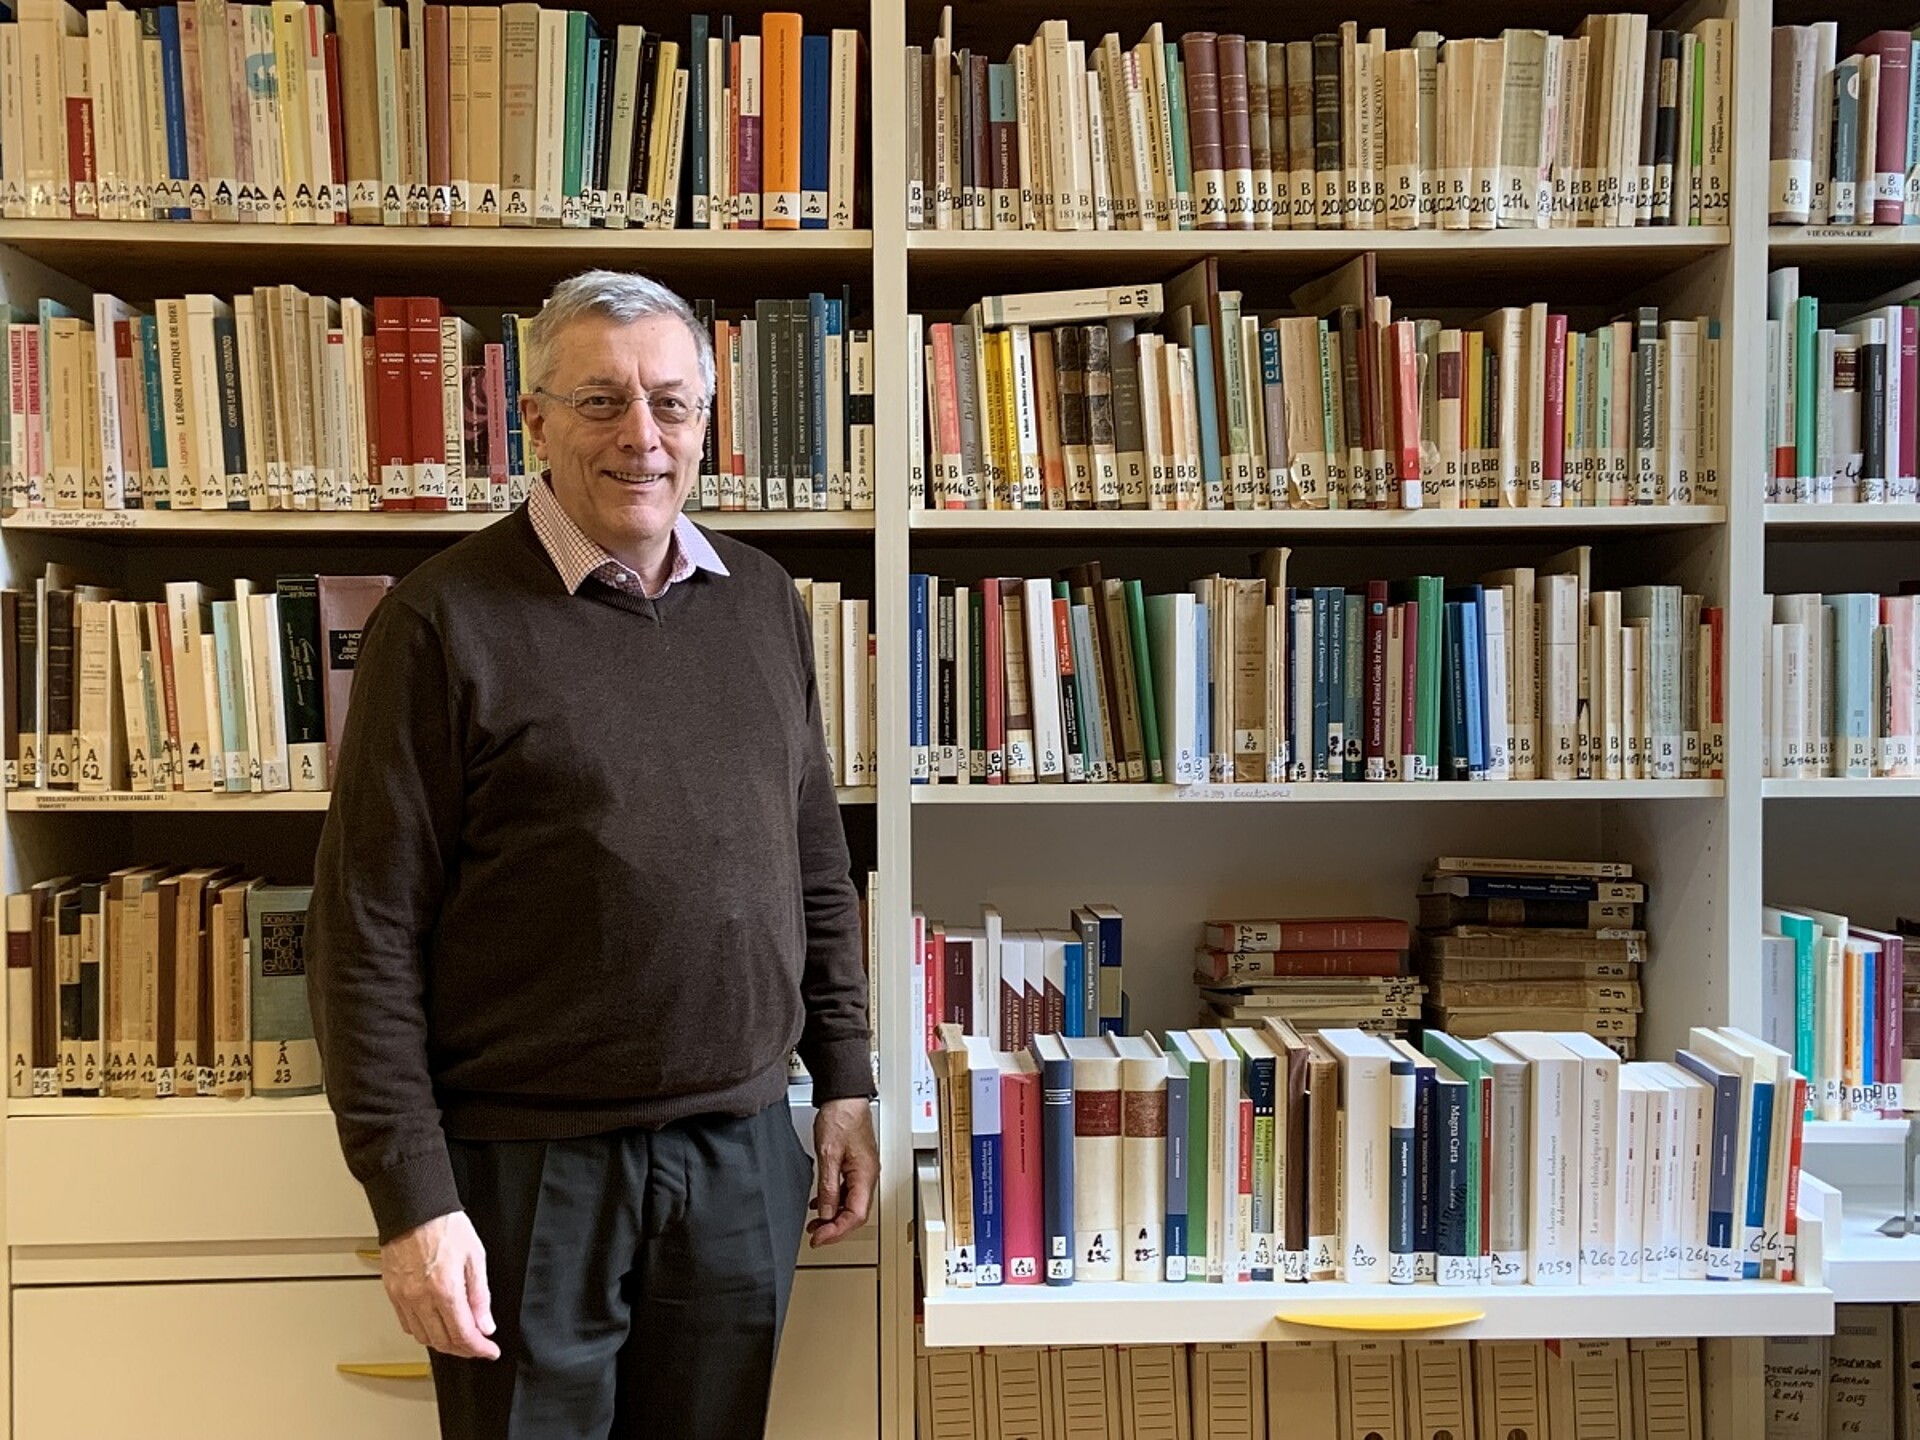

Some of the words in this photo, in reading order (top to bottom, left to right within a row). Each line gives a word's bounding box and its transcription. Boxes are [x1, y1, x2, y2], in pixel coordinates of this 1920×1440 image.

[1389, 195, 1416, 210] 207
[1446, 196, 1470, 211] 210
[1471, 198, 1496, 212] 210
[1704, 194, 1729, 208] 225
[996, 211, 1017, 223] 180
[168, 302, 177, 323] DIEU
[169, 325, 178, 337] DE
[442, 318, 458, 388] POULAT
[1263, 332, 1274, 379] CLIO
[171, 340, 182, 385] POLITIQUE
[176, 415, 185, 425] LE
[1299, 480, 1316, 494] 138
[1333, 640, 1340, 648] of
[1373, 654, 1381, 663] for
[1373, 665, 1381, 681] Guide
[51, 763, 69, 776] 60
[82, 764, 103, 780] 62
[65, 1070, 74, 1082] 5
[86, 1069, 93, 1081] 6
[141, 1070, 156, 1083] 12
[273, 1069, 292, 1083] 23
[1592, 1099, 1600, 1121] droit
[1448, 1105, 1460, 1136] Magna
[1592, 1122, 1600, 1135] du
[1450, 1138, 1460, 1163] Carta
[1352, 1256, 1376, 1266] 250
[1494, 1265, 1520, 1275] 257
